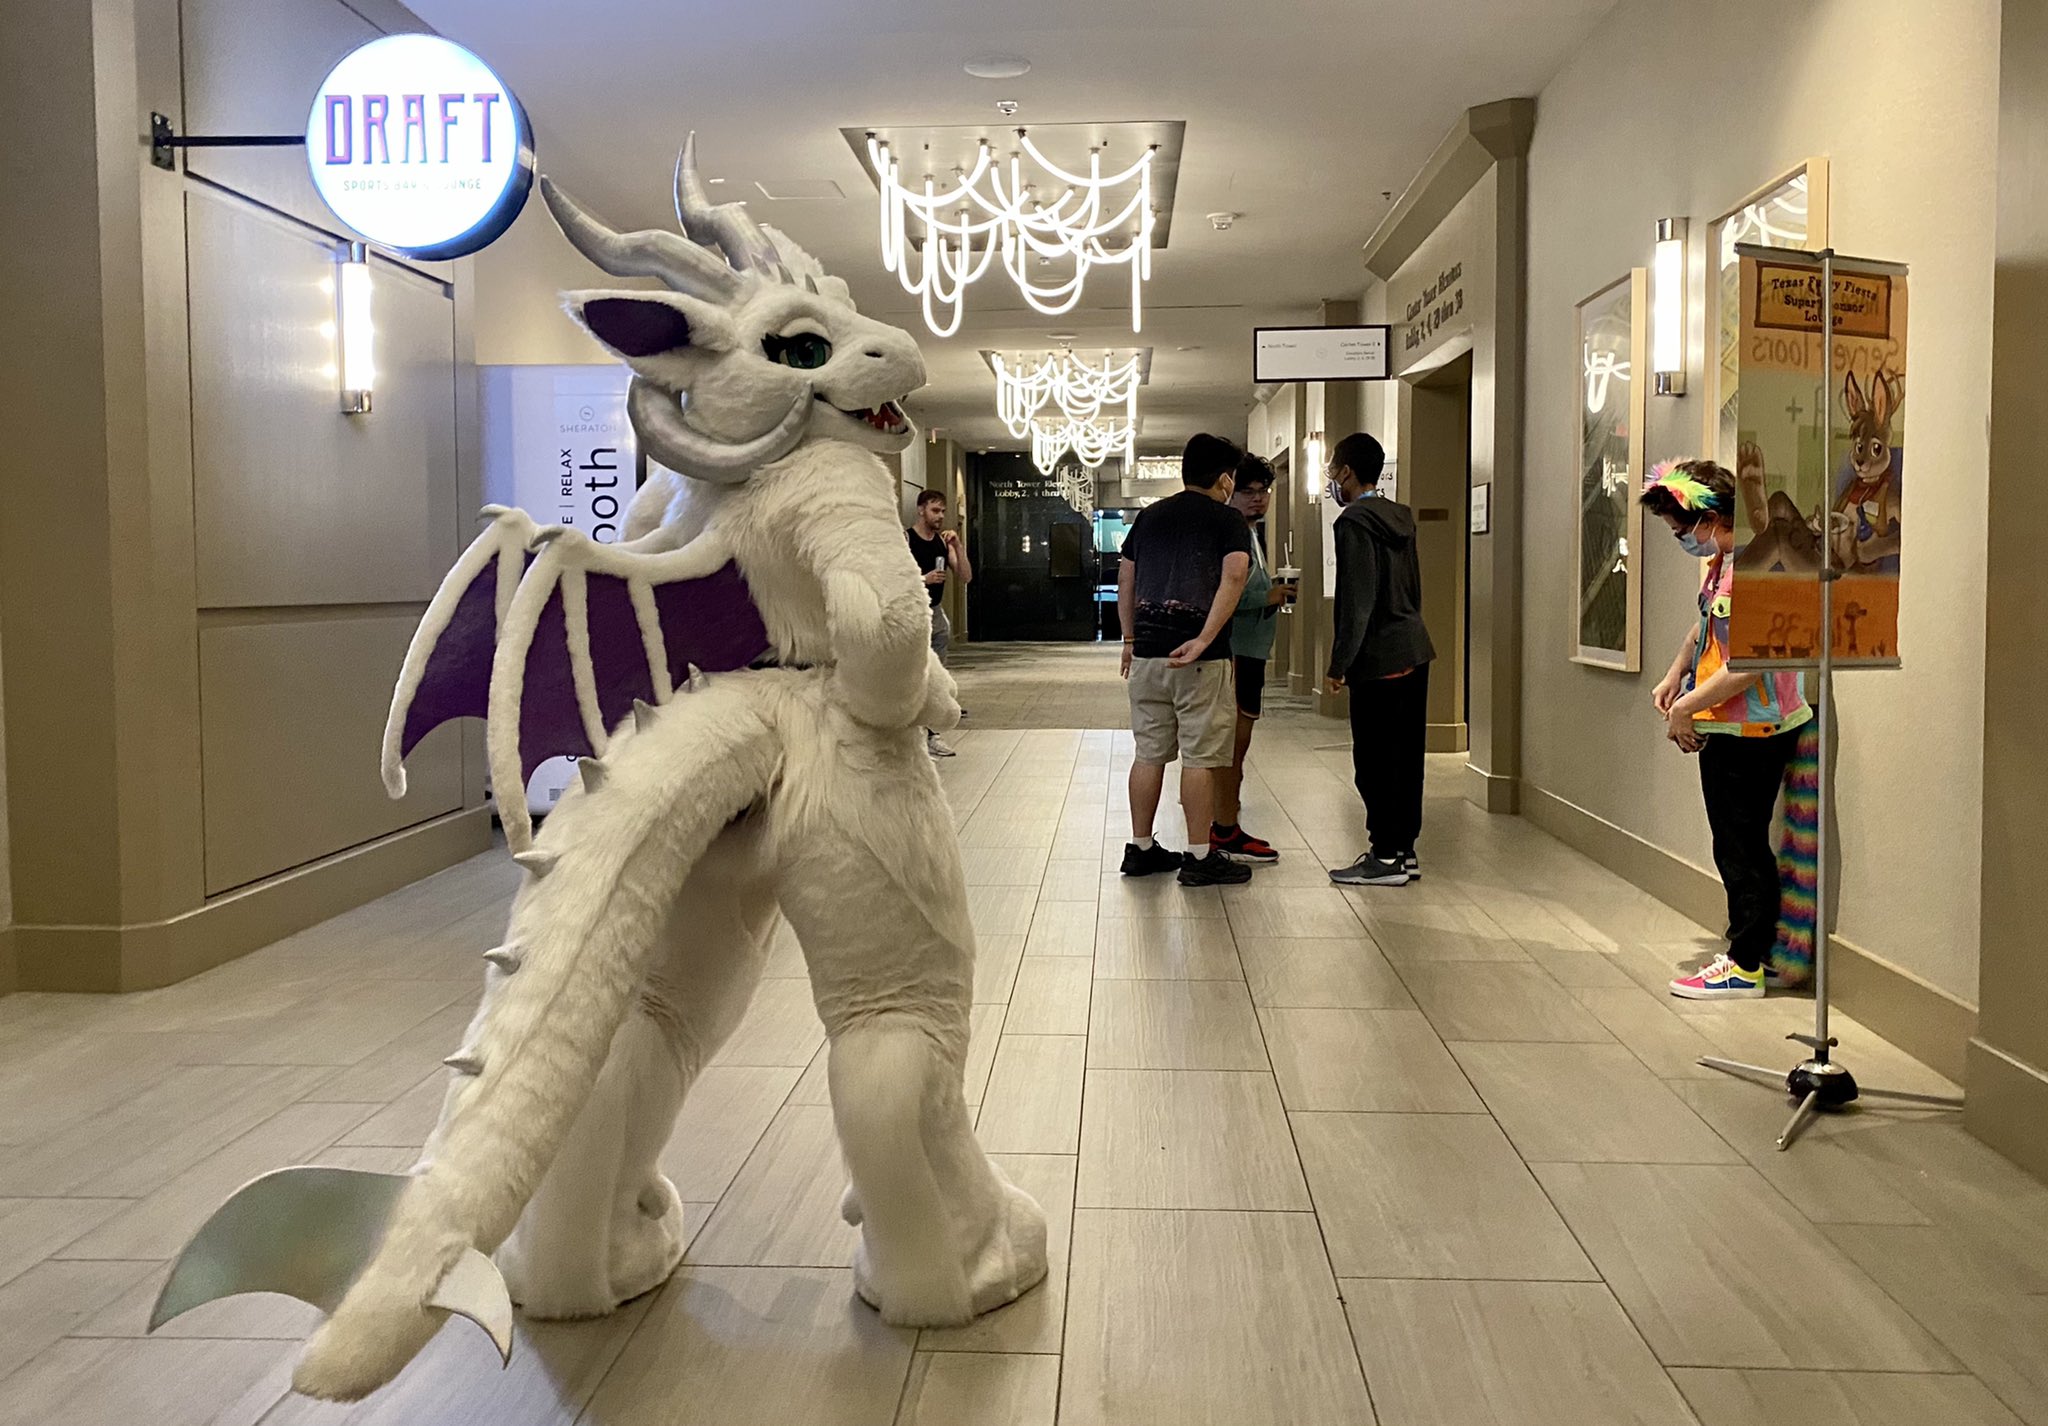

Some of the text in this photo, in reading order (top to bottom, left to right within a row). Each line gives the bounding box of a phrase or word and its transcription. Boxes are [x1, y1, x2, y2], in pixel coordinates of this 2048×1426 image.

[325, 93, 499, 165] DRAFT
[1772, 276, 1877, 301] Texas Fuy Fiesta
[1784, 295, 1864, 313] Super onsor
[1805, 311, 1843, 326] Loge
[560, 424, 617, 433] SHERATON
[561, 449, 572, 496] RELAX
[989, 480, 1013, 488] North
[1016, 480, 1041, 488] Tower
[579, 448, 619, 544] ooth
